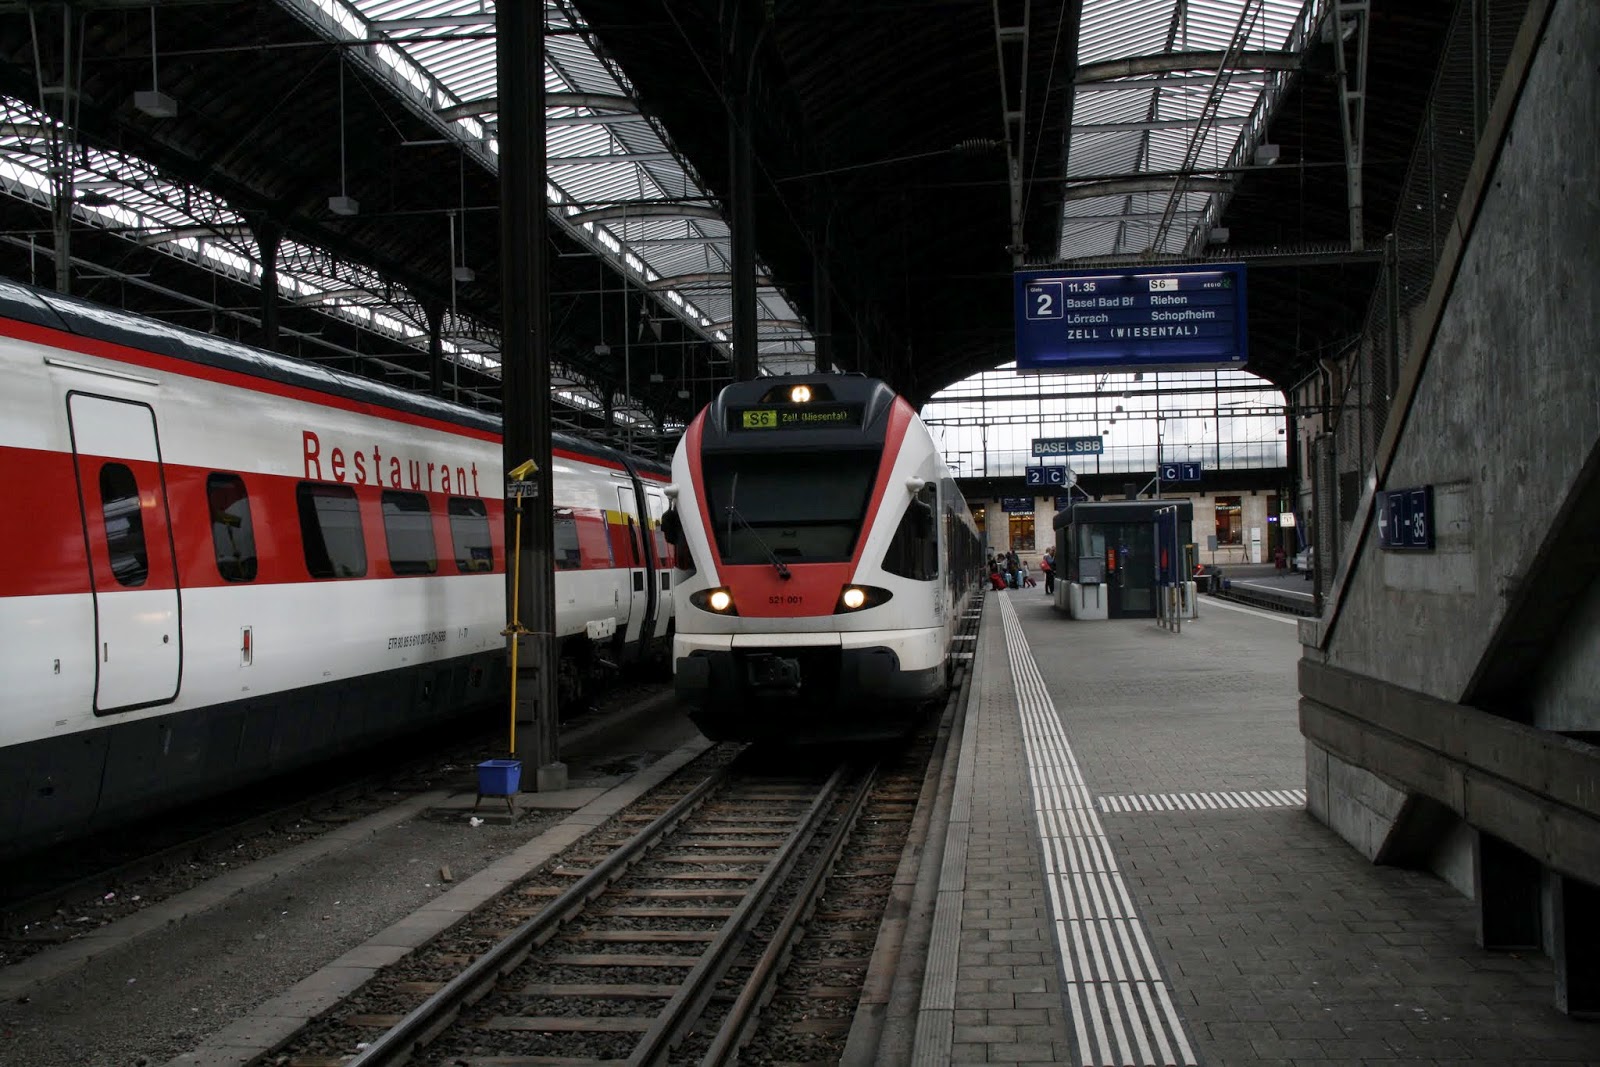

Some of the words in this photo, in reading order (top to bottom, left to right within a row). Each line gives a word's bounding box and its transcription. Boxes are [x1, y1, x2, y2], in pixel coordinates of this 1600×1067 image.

[1068, 282, 1096, 292] 11.35
[1036, 294, 1052, 316] 2
[1066, 298, 1096, 308] Basel
[1098, 298, 1119, 308] Bad
[1122, 297, 1134, 306] Bf
[1150, 295, 1188, 305] Riehen
[1067, 314, 1108, 324] Lörrach
[1151, 310, 1215, 322] Schopfheim
[1067, 330, 1100, 340] ZELL
[1110, 326, 1199, 338] (WIESENTAL)
[750, 412, 769, 425] S6
[782, 412, 798, 422] Zell
[801, 411, 848, 422] (Wiesental)
[1034, 442, 1073, 454] BASEL
[1075, 440, 1100, 452] SBB
[302, 430, 480, 497] Restaurant
[1032, 472, 1040, 482] 2
[1051, 472, 1060, 482] C
[1166, 468, 1176, 479] C
[1188, 468, 1194, 478] 1
[1394, 514, 1398, 538] 1
[1413, 512, 1424, 538] 35
[769, 596, 784, 604] 521
[788, 596, 802, 604] 001
